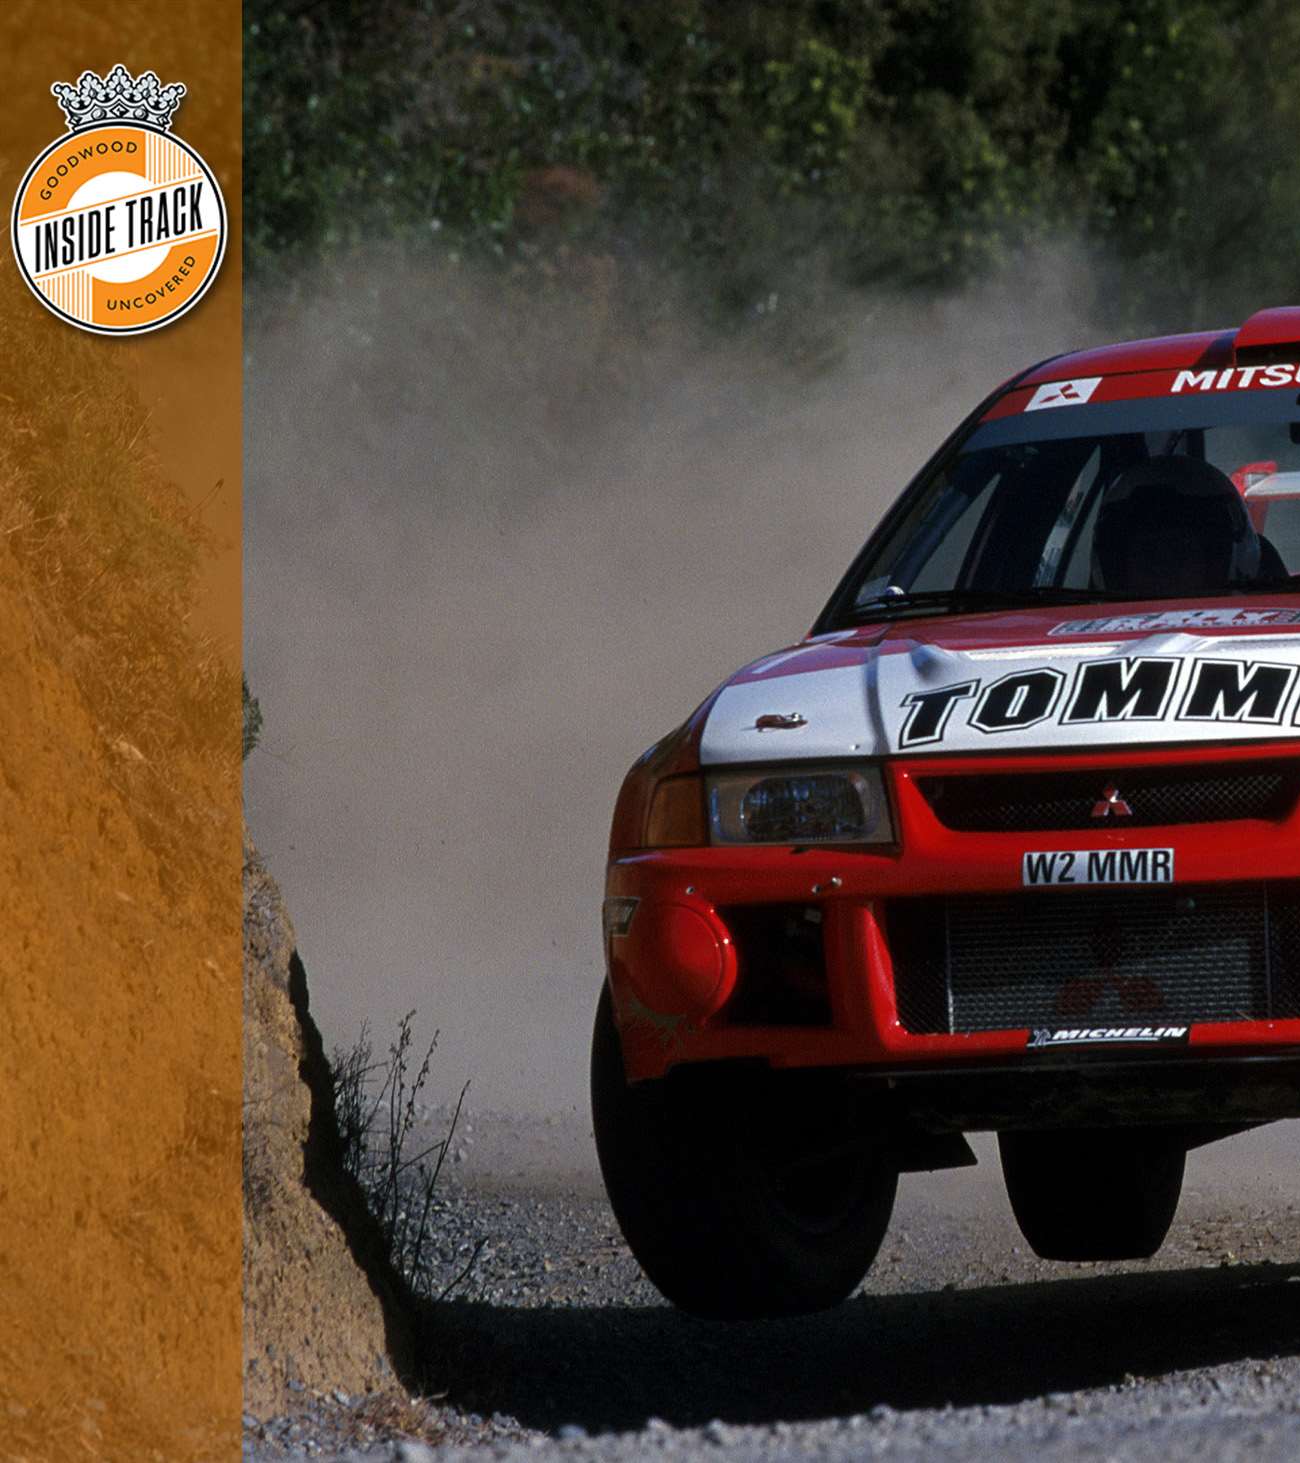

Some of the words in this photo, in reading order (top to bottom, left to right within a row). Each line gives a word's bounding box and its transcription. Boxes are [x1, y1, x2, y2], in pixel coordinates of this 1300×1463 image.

[1025, 852, 1076, 884] W2
[1087, 850, 1171, 882] MMR
[1051, 1027, 1187, 1041] MICHELIN
